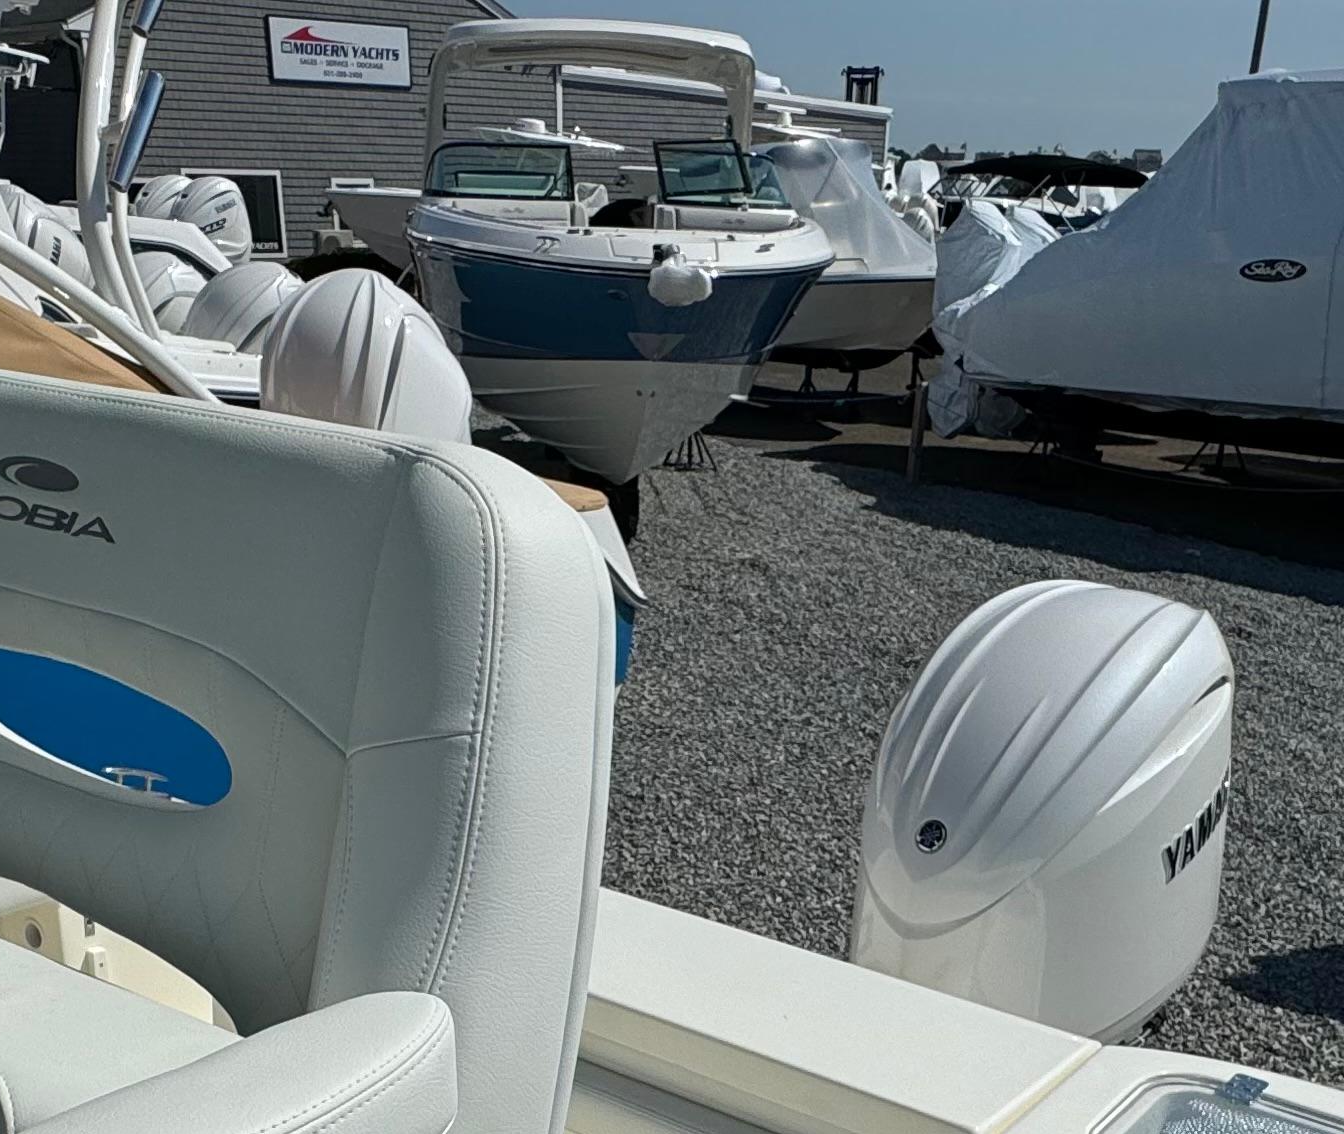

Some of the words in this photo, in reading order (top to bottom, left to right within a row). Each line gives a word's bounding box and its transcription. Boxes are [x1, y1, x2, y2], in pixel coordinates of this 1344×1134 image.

[292, 42, 349, 58] MODERN
[351, 46, 399, 62] YACHTS
[1161, 766, 1231, 885] YAMA
